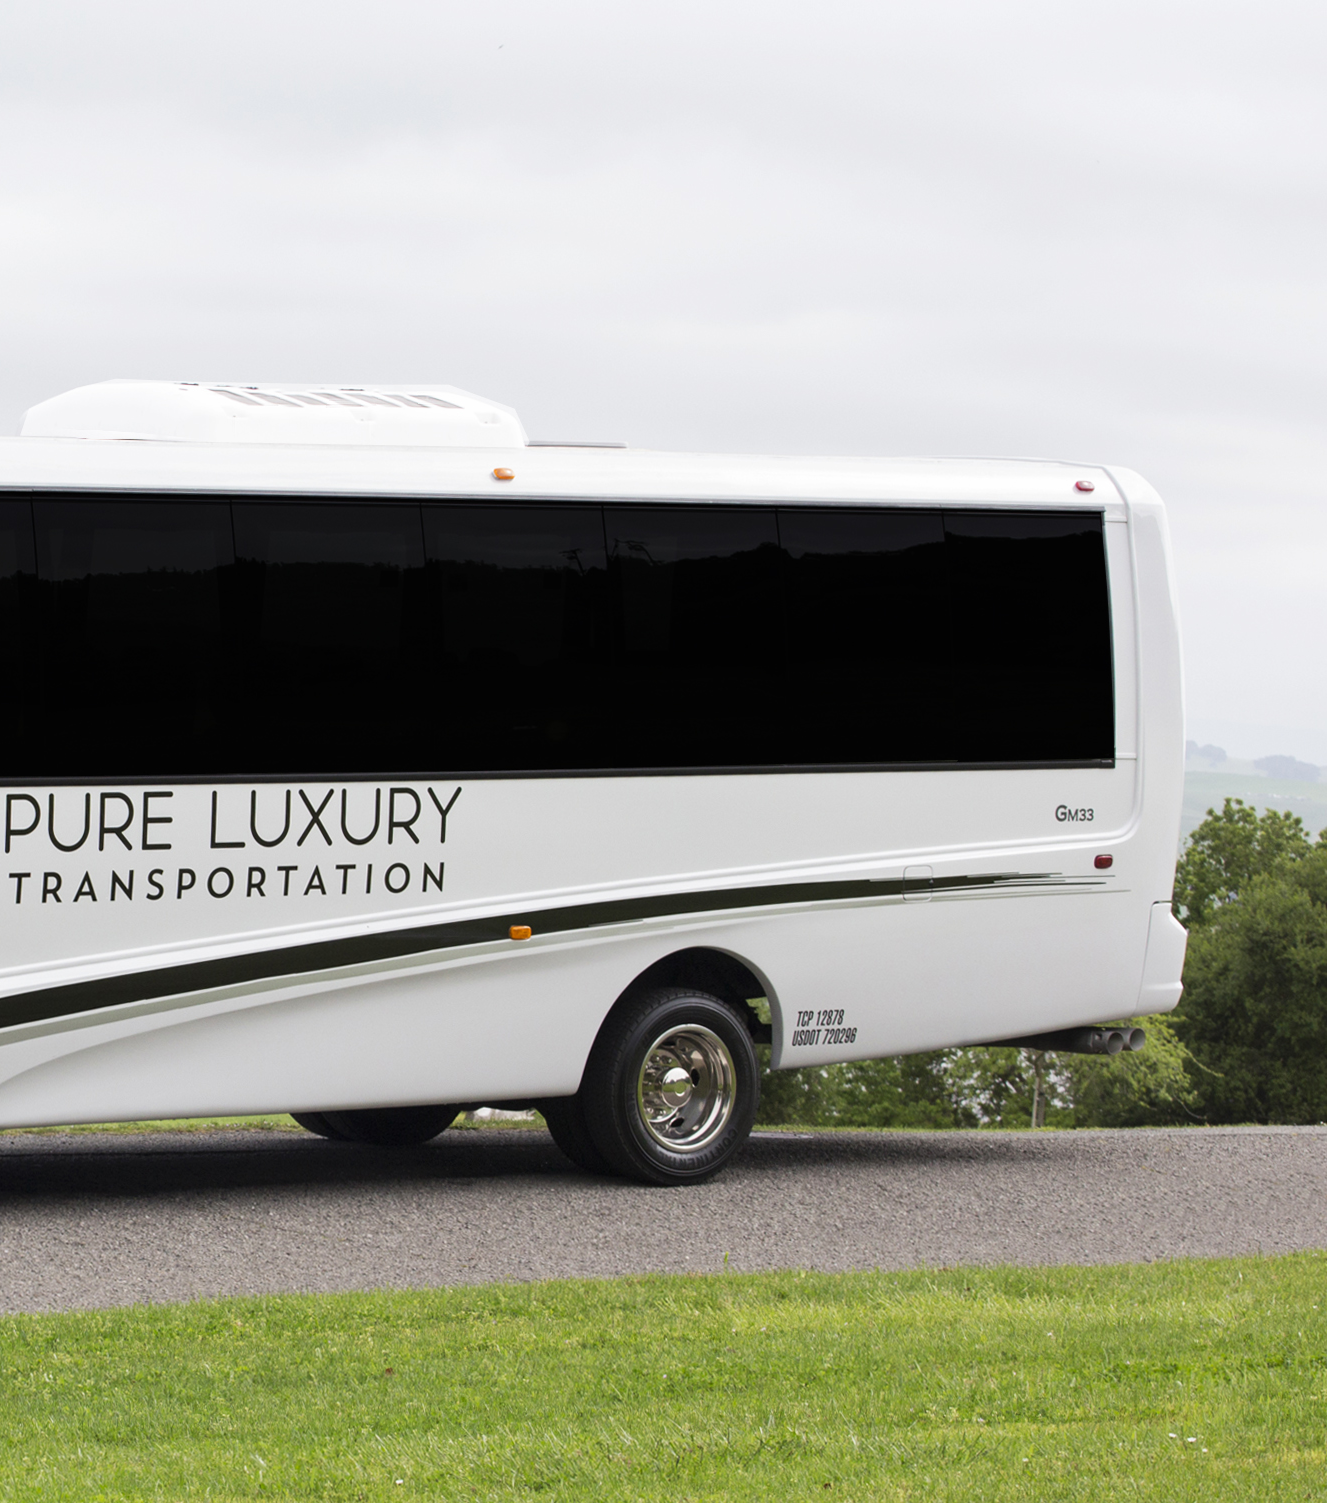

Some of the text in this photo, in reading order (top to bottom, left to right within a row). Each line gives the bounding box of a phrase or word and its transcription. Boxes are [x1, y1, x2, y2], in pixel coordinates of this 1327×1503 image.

[4, 786, 462, 854] PURE LUXURY
[8, 861, 446, 905] TRANSPORTATION
[796, 1009, 844, 1027] TCP 12878
[792, 1027, 857, 1046] USDOT 720296
